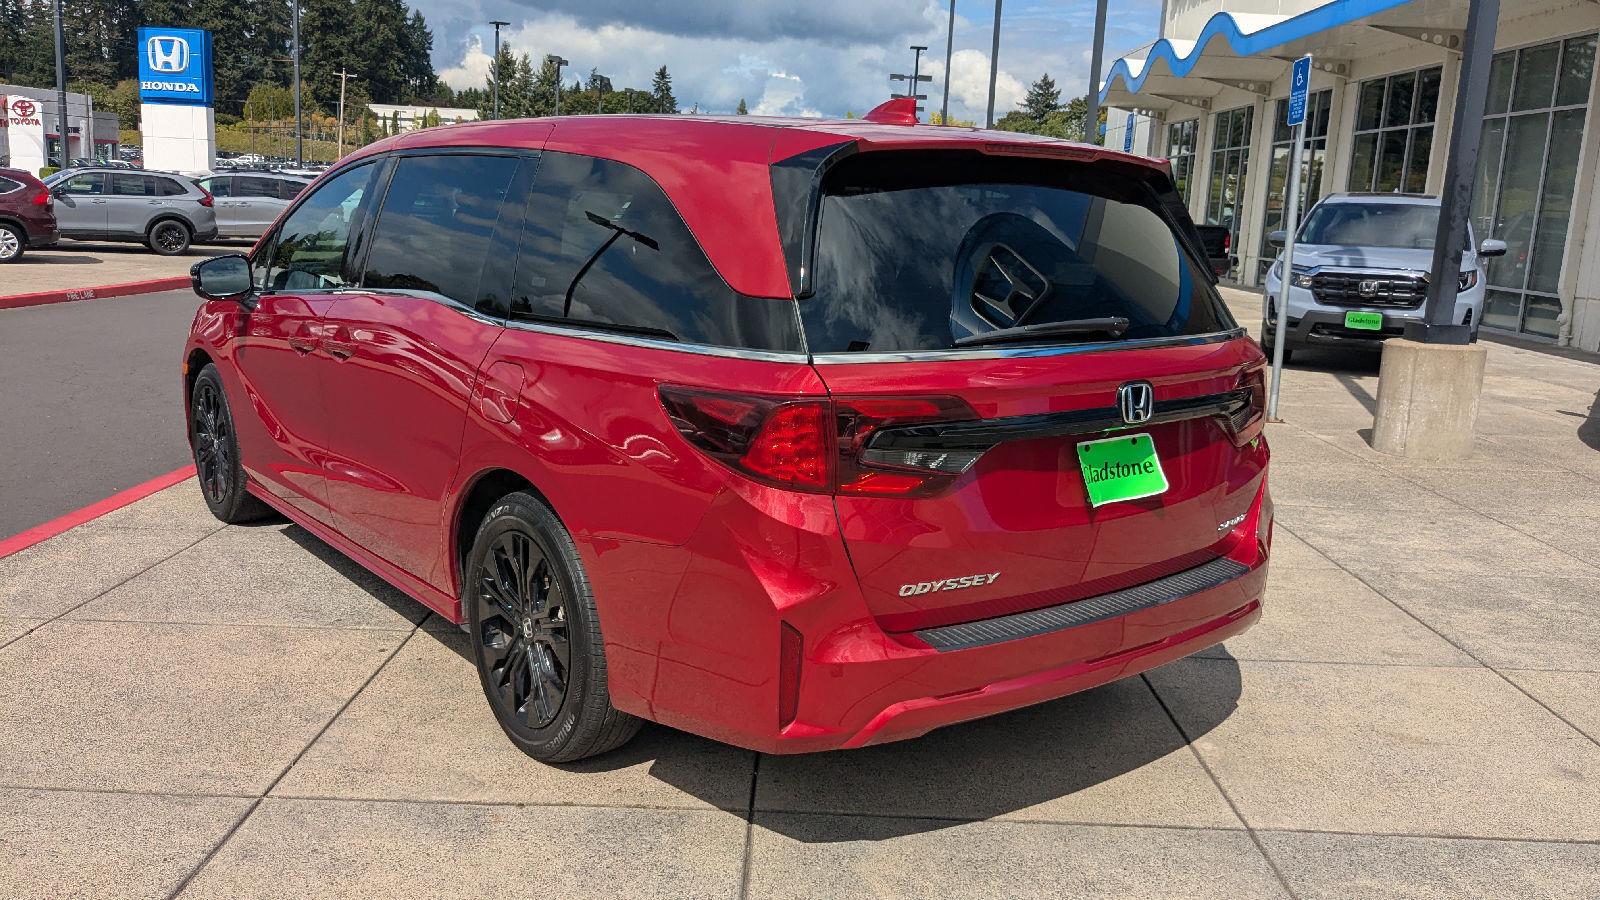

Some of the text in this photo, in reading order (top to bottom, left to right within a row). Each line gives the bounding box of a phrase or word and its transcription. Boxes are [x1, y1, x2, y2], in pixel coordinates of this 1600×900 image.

[140, 81, 200, 93] HONDA
[9, 117, 41, 126] TOYOTA
[899, 572, 1001, 597] ODYSSEY
